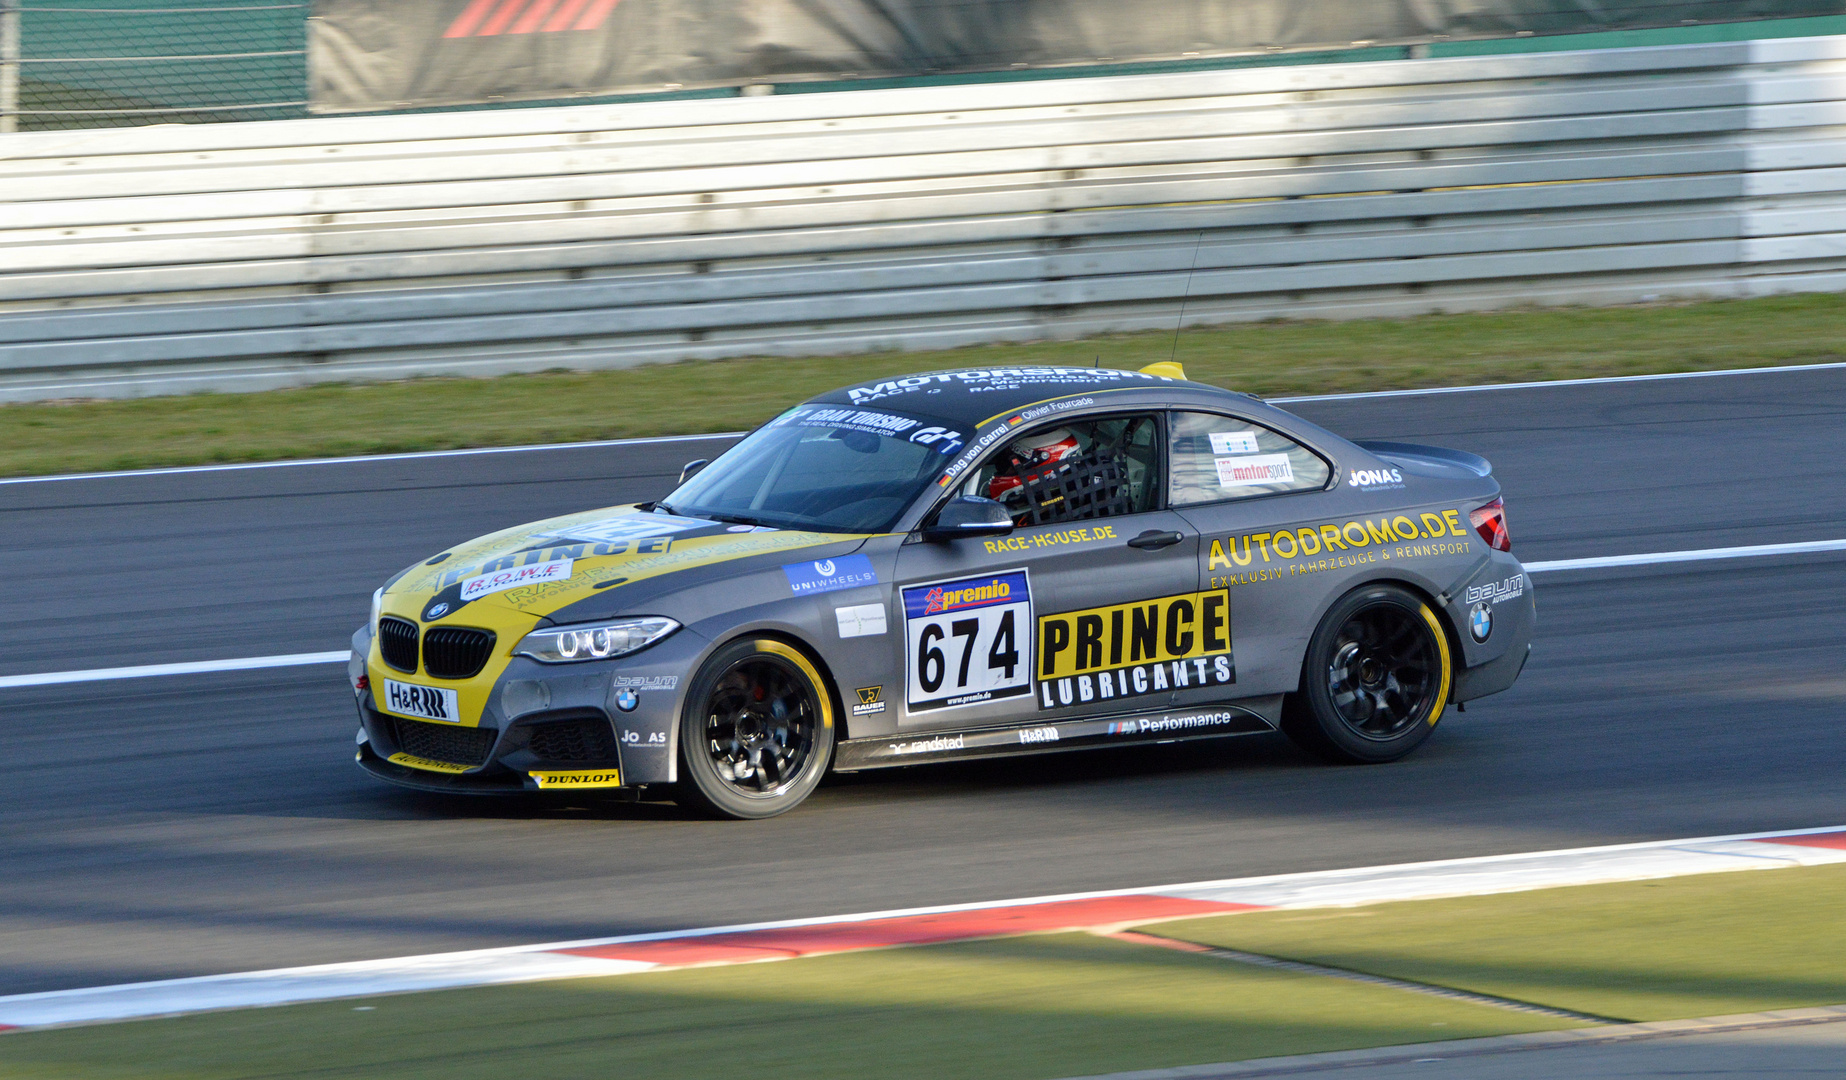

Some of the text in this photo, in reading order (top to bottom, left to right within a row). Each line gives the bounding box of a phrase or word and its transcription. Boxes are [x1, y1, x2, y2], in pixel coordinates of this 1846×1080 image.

[848, 368, 1173, 400] MOTORSPORT
[805, 409, 918, 432] GRAN TURISMO
[1021, 397, 1094, 420] Olivier Fourcade
[827, 421, 856, 430] DRIVING
[855, 424, 896, 437] SIMULATOR
[945, 423, 1009, 477] Dag von Garrel
[1348, 468, 1403, 487] JONAS
[983, 526, 1118, 554] RACE-HOUSE.DE
[1208, 509, 1467, 571] AUTODROMO.DE
[443, 538, 665, 587] PRINCE
[1211, 542, 1471, 589] EXKLUSIV FAHRZEUGE & RENNSPORT
[465, 572, 557, 596] MOTOR OIL
[468, 563, 563, 590] ROWE
[1466, 573, 1524, 604] baum
[942, 579, 1010, 611] premio
[1492, 588, 1523, 604] AUTOMOBILE
[1042, 595, 1227, 676] PRINCE
[918, 609, 1019, 693] 674
[613, 675, 679, 687] baum
[1041, 656, 1231, 708] LUBRICANTS
[853, 701, 885, 712] BAUER
[947, 691, 992, 705] www.premio.de
[1139, 712, 1232, 733] Performance
[911, 734, 965, 750] randstad
[1019, 728, 1047, 744] H&R
[546, 774, 616, 784] DUNLOP
